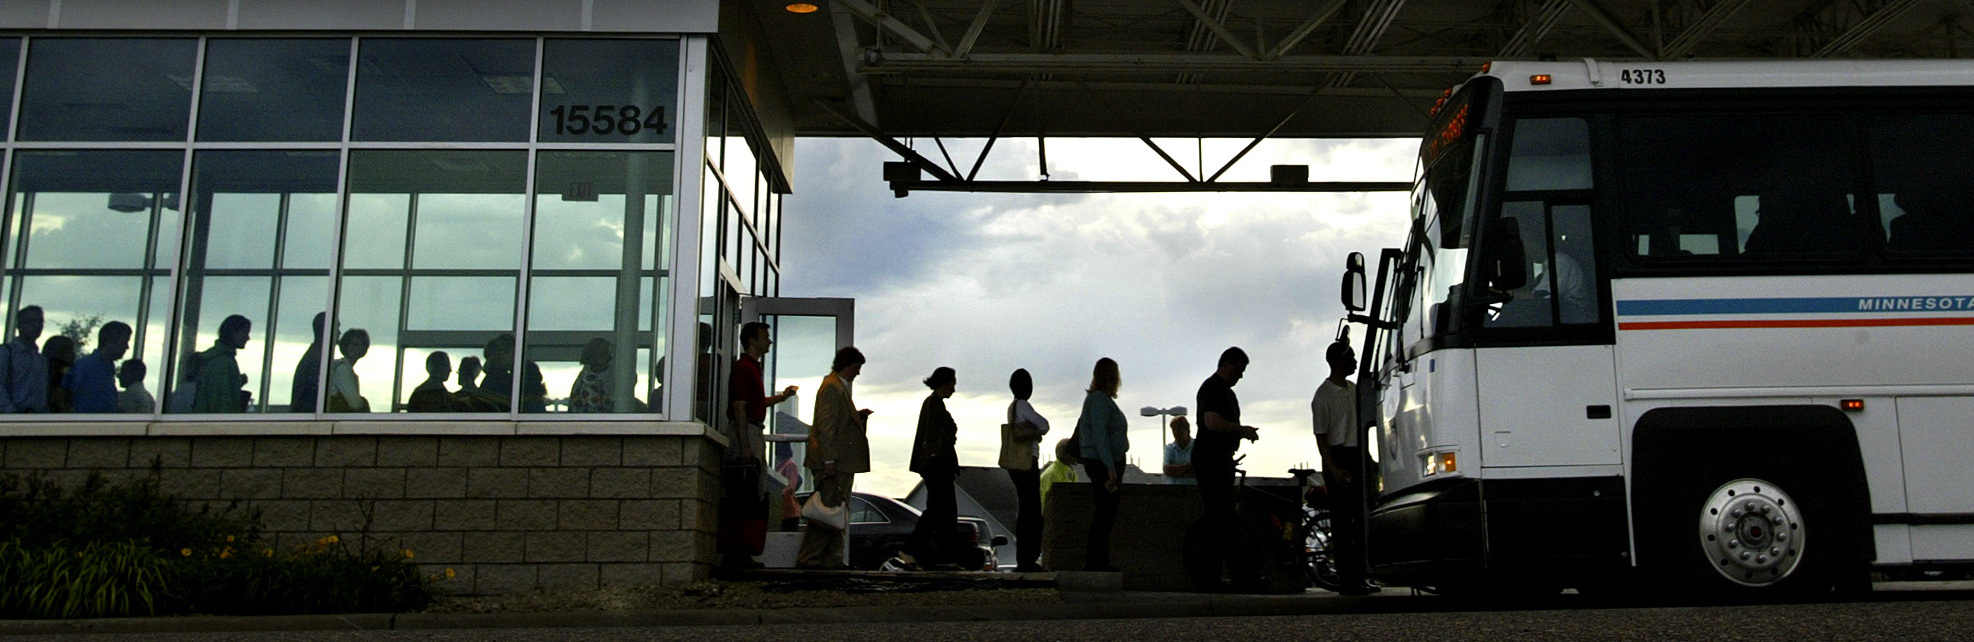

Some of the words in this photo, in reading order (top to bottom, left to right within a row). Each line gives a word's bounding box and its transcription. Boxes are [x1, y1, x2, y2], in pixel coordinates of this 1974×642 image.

[1621, 69, 1666, 84] 4373
[550, 105, 668, 135] 15584
[1858, 297, 1974, 310] MINNESOTA
